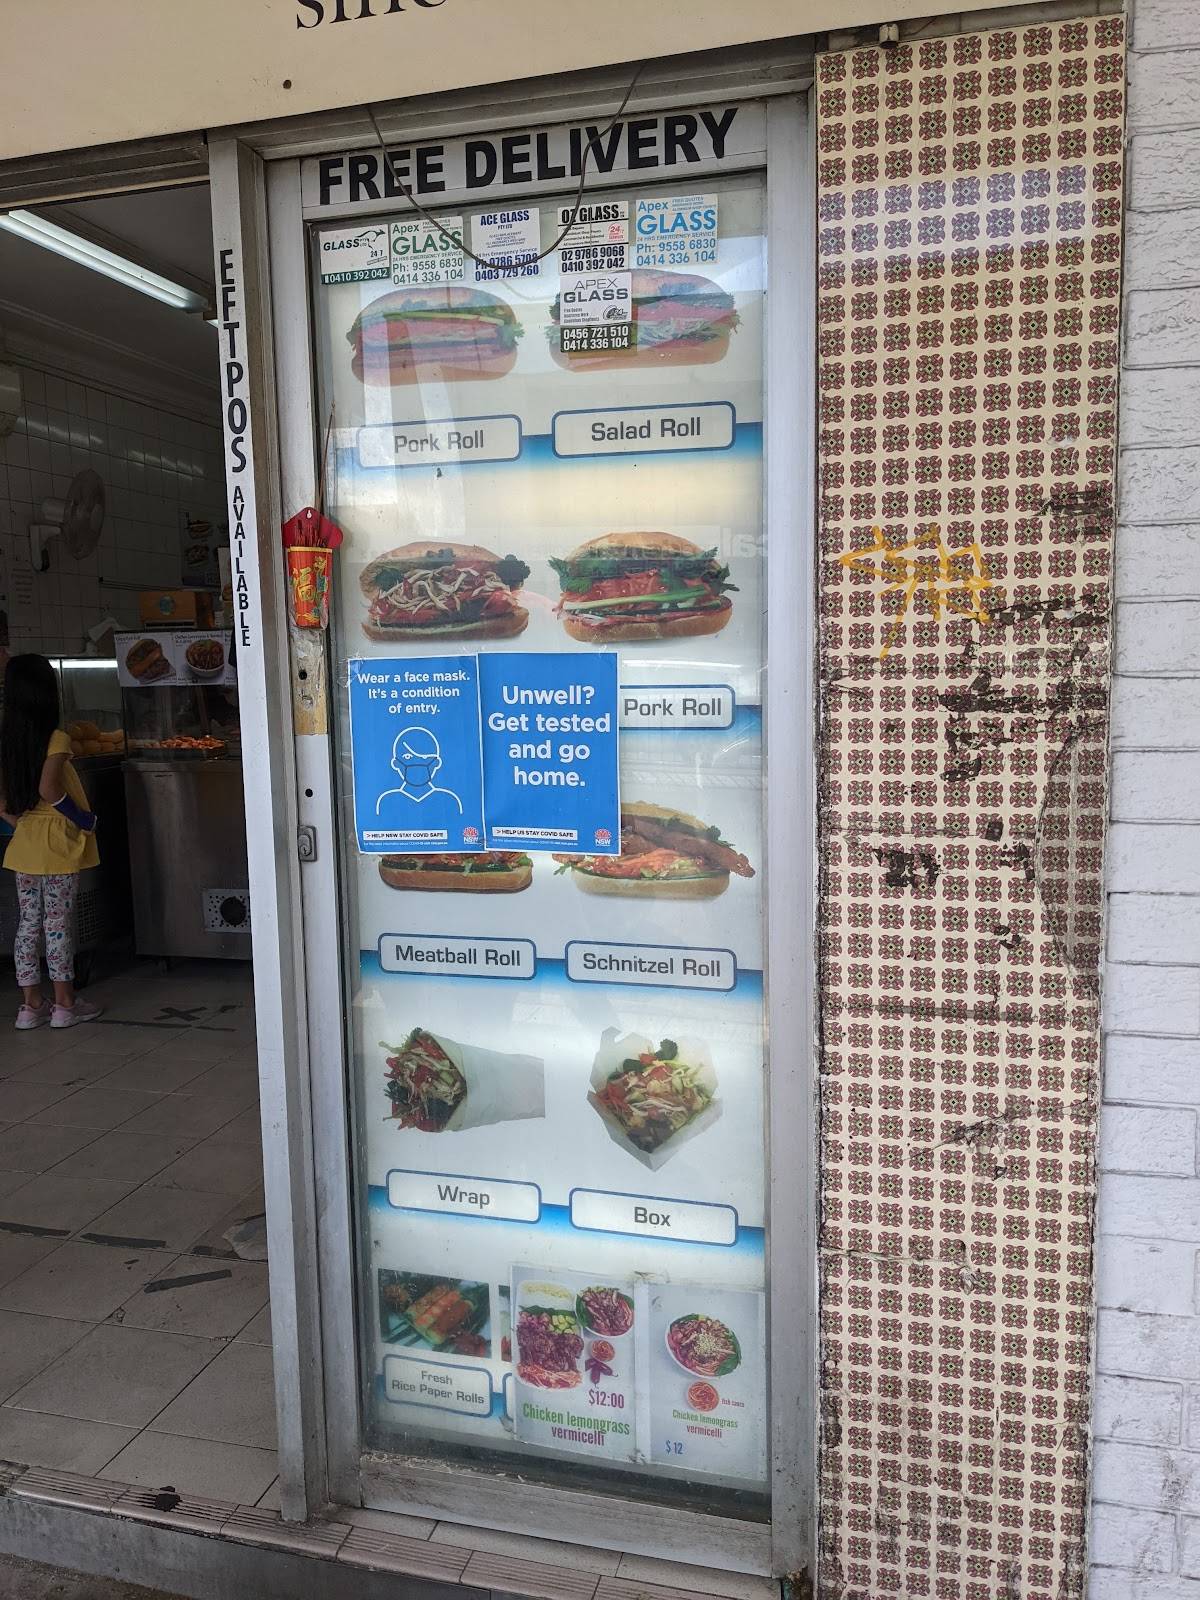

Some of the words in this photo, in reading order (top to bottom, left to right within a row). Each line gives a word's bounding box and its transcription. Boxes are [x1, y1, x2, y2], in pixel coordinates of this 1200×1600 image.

[319, 145, 445, 205] FREE
[465, 108, 739, 189] DELIVERY
[562, 208, 576, 224] OZ
[580, 205, 619, 222] GLASS
[638, 201, 668, 213] Apex
[480, 214, 498, 226] ACE
[500, 210, 529, 224] GLASS
[638, 210, 716, 234] GLASS
[392, 224, 419, 235] Apex
[323, 239, 359, 251] GLASS
[392, 231, 463, 255] GLASS
[637, 243, 655, 253] Ph:
[659, 241, 685, 252] 9558
[689, 238, 716, 249] 6830
[562, 250, 573, 261] 02
[575, 247, 598, 260] 9786
[600, 245, 624, 258] 9068
[637, 254, 665, 266] 0414
[669, 252, 690, 264] 336
[694, 250, 715, 262] 104
[393, 263, 409, 273] Ph:
[412, 260, 436, 270] 9558
[440, 258, 463, 268] 6830
[475, 269, 499, 281] 0403
[502, 267, 518, 278] 729
[521, 264, 539, 277] 260
[562, 261, 584, 273] 0410
[586, 259, 604, 270] 392
[607, 257, 624, 269] 042
[330, 273, 351, 283] 0410
[353, 271, 369, 280] 392
[371, 269, 388, 278] 042
[393, 273, 418, 284] 0414
[422, 271, 440, 282] 336
[445, 269, 463, 280] 104
[574, 278, 618, 291] APEX
[564, 288, 628, 303] GLASS
[564, 328, 588, 340] 0456
[591, 327, 608, 338] 721
[610, 326, 628, 336] 510
[564, 340, 588, 351] 0414
[590, 338, 608, 349] 336
[610, 337, 628, 348] 104
[220, 249, 247, 473] EFTPOS
[591, 418, 651, 442] Salad
[660, 417, 701, 437] Roll
[394, 432, 440, 454] Pork
[448, 430, 484, 450] Roll
[233, 486, 250, 646] AVAILABLE
[358, 673, 390, 684] Wear
[394, 675, 400, 683] a
[405, 672, 430, 682] face
[433, 670, 470, 682] mask.
[369, 688, 387, 699] It's
[391, 690, 398, 698] a
[402, 686, 460, 698] condition
[502, 685, 595, 705] Unwell?
[388, 703, 401, 714] of
[406, 705, 440, 715] entry.
[624, 699, 673, 716] Pork
[682, 698, 721, 716] Roll
[488, 712, 529, 732] Get
[536, 713, 611, 732] tested
[508, 740, 551, 759] and
[559, 744, 590, 763] go
[514, 766, 586, 787] home.
[395, 945, 477, 965] Meatball
[485, 949, 520, 967] Roll
[583, 953, 674, 974] Schnitzel
[682, 958, 721, 977] Roll
[438, 1184, 490, 1209] Wrap
[634, 1207, 671, 1227] Box
[422, 1371, 453, 1385] Fresh
[392, 1380, 416, 1392] Rice
[420, 1384, 452, 1398] Paper
[456, 1391, 484, 1404] Rolls
[589, 1389, 624, 1408] $12:00
[523, 1403, 564, 1424] Chicken
[567, 1412, 630, 1435] lemongrass
[672, 1409, 698, 1421] Chicken
[700, 1415, 738, 1428] lemongrass
[552, 1426, 604, 1446] vermicelli
[687, 1425, 722, 1438] vermicelli
